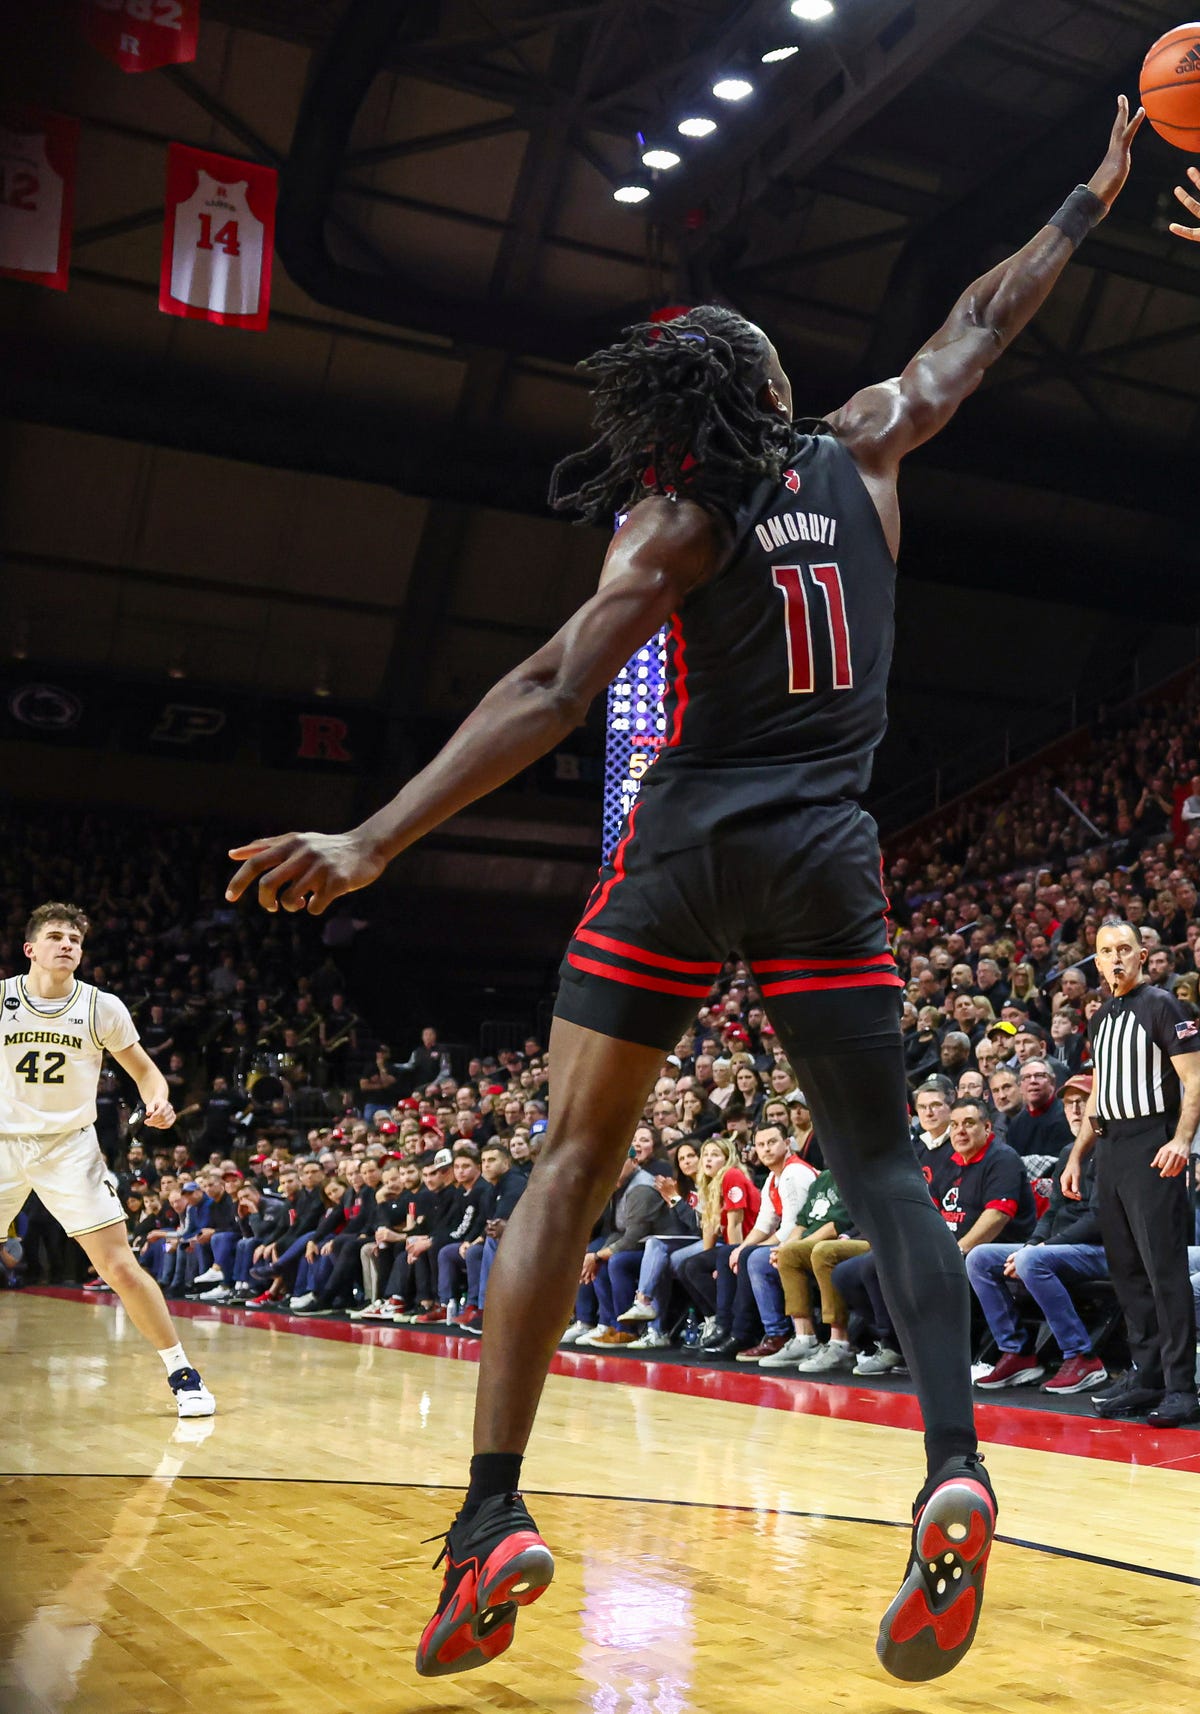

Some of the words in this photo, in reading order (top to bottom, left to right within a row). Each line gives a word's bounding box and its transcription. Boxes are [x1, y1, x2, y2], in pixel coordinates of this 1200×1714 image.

[197, 213, 241, 256] 14
[755, 512, 837, 552] OMORUYI
[771, 563, 853, 693] 11
[296, 712, 353, 763] R
[4, 1031, 83, 1049] MICHIGAN
[15, 1051, 66, 1084] 42
